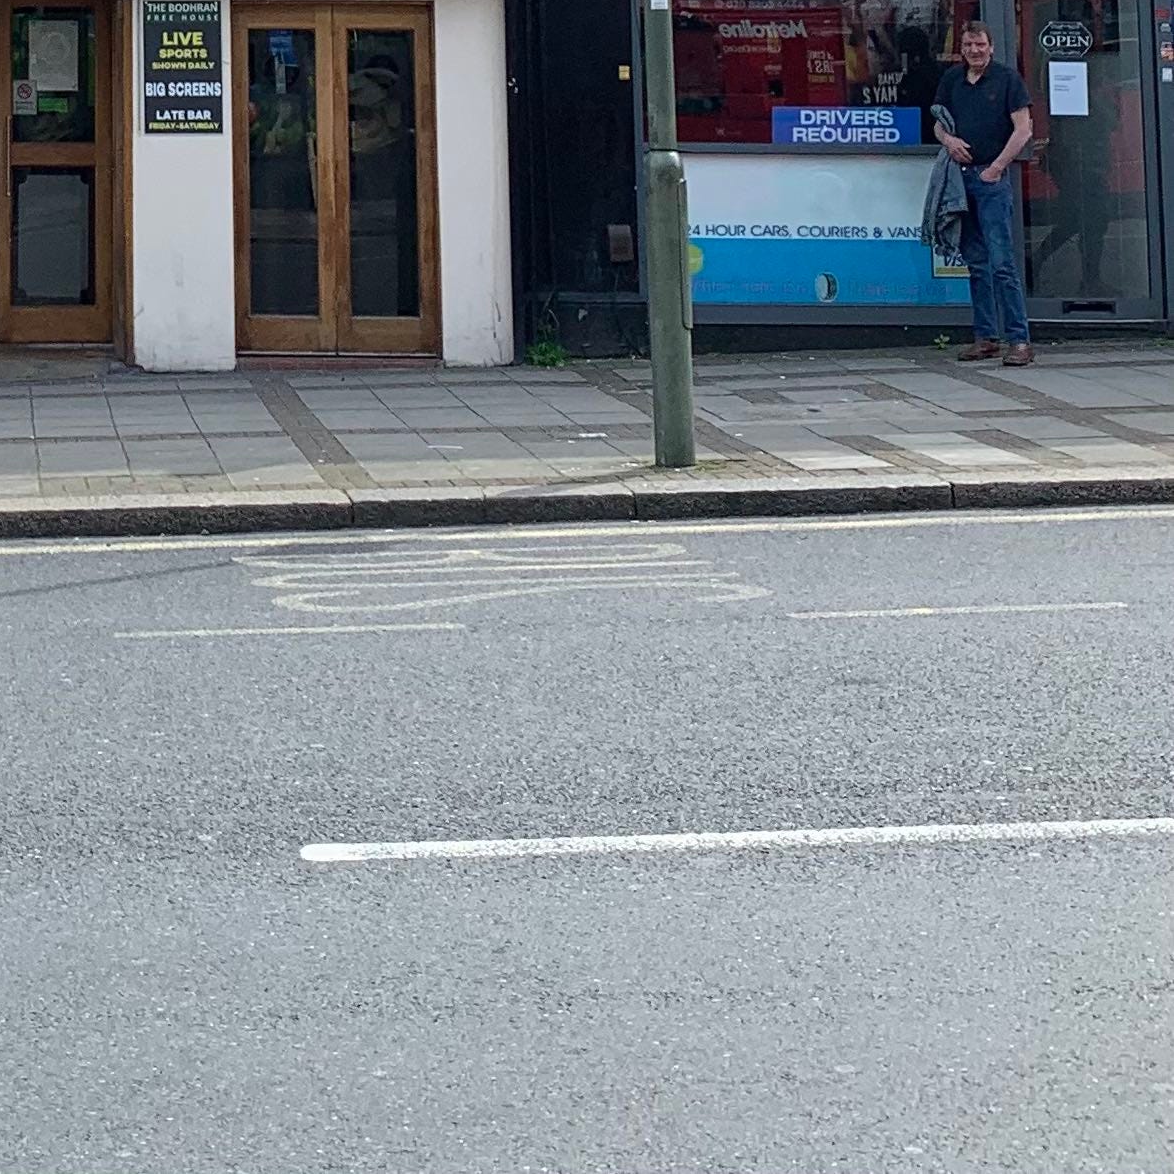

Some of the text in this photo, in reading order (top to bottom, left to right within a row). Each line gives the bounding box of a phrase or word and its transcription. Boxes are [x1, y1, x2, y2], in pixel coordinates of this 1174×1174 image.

[147, 2, 218, 13] THE BODHRAN
[162, 31, 204, 46] LIVE
[1042, 34, 1090, 48] OPEN
[158, 48, 208, 59] SPORTS
[151, 61, 215, 70] SHOWN DAILY
[145, 82, 222, 97] BIG SCREENS
[156, 109, 212, 121] LATE BAR
[800, 110, 894, 125] DRIVERS
[792, 127, 900, 143] REQUIRED
[705, 224, 746, 237] HOUR
[750, 224, 791, 238] CARS,
[797, 225, 868, 238] COURIERS
[874, 226, 883, 238] &
